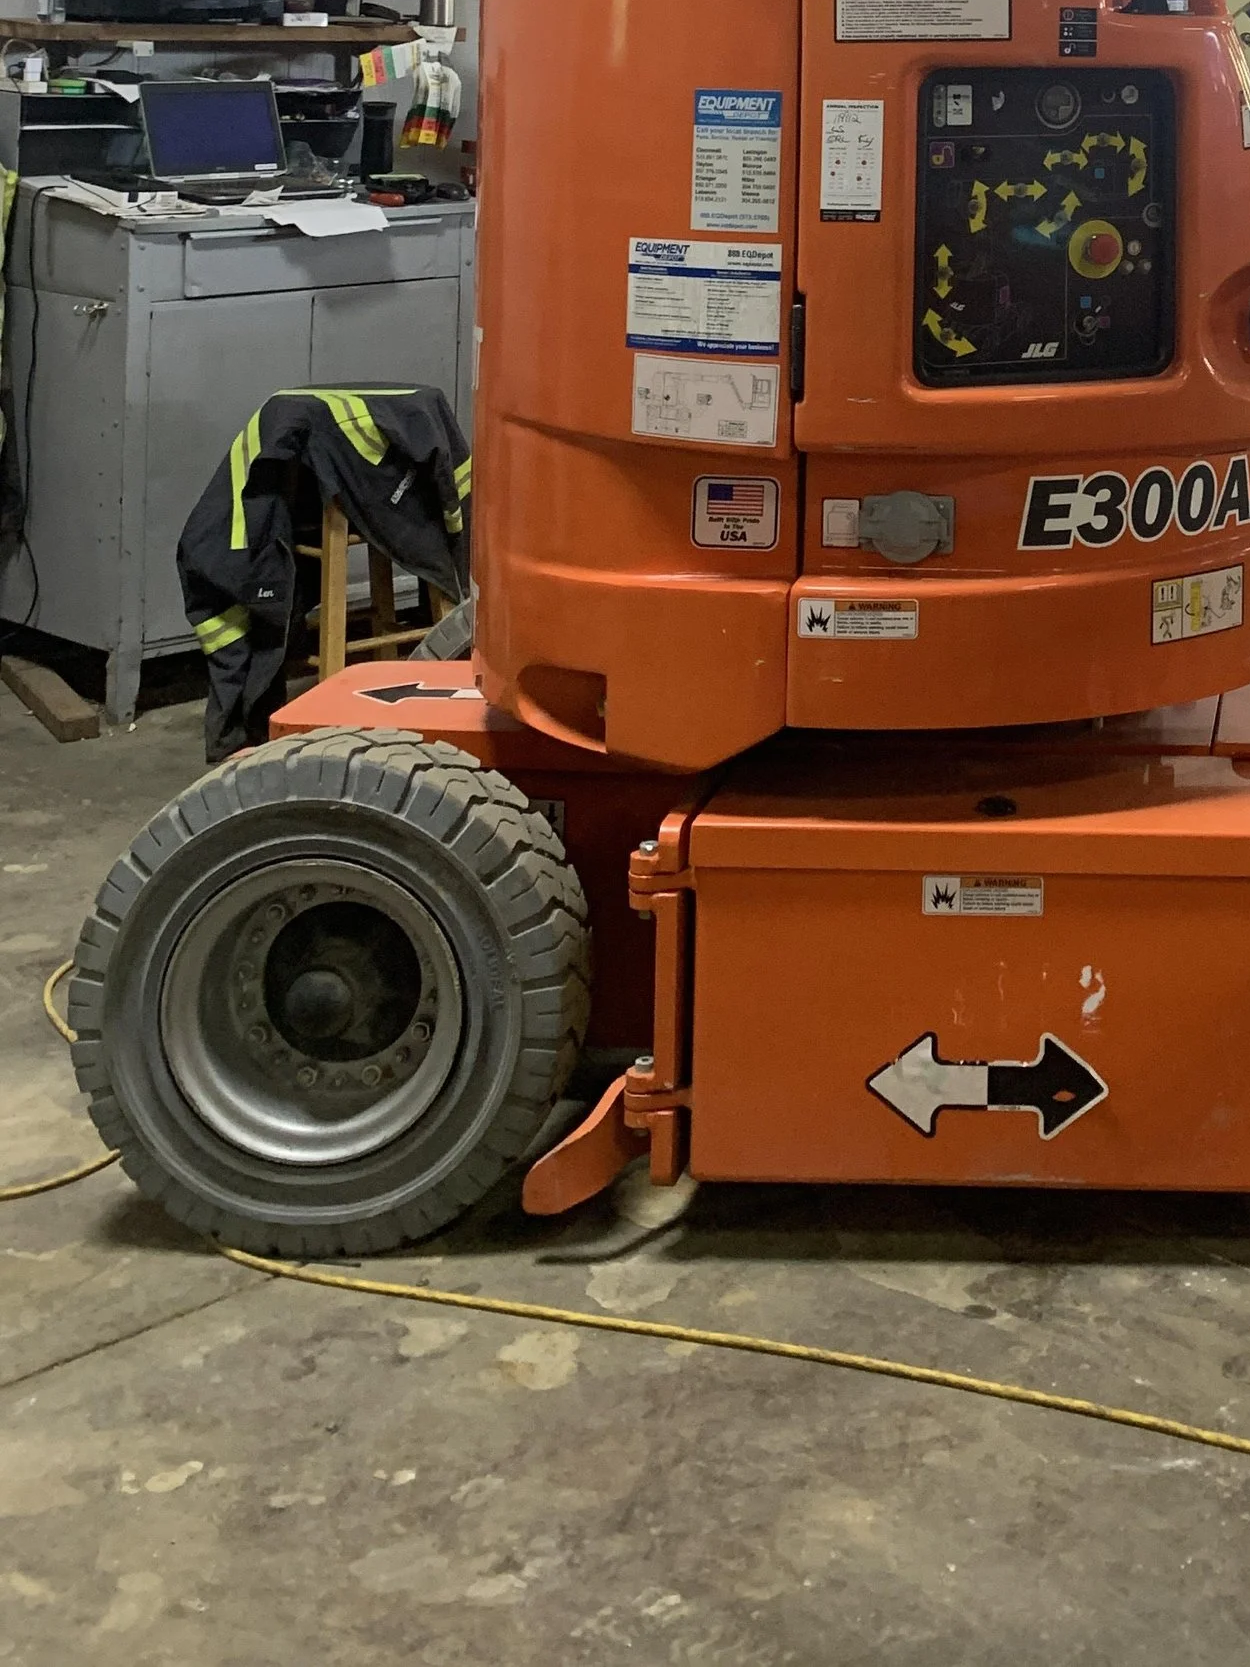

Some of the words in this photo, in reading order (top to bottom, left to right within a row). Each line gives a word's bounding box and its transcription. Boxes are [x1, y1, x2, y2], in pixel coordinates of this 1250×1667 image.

[698, 95, 776, 111] EQUIPMENT
[635, 241, 690, 255] EQUIPMENT
[1021, 342, 1060, 359] JLG
[720, 530, 747, 542] USA
[858, 602, 902, 612] WARNING
[984, 878, 1027, 887] WARNING
